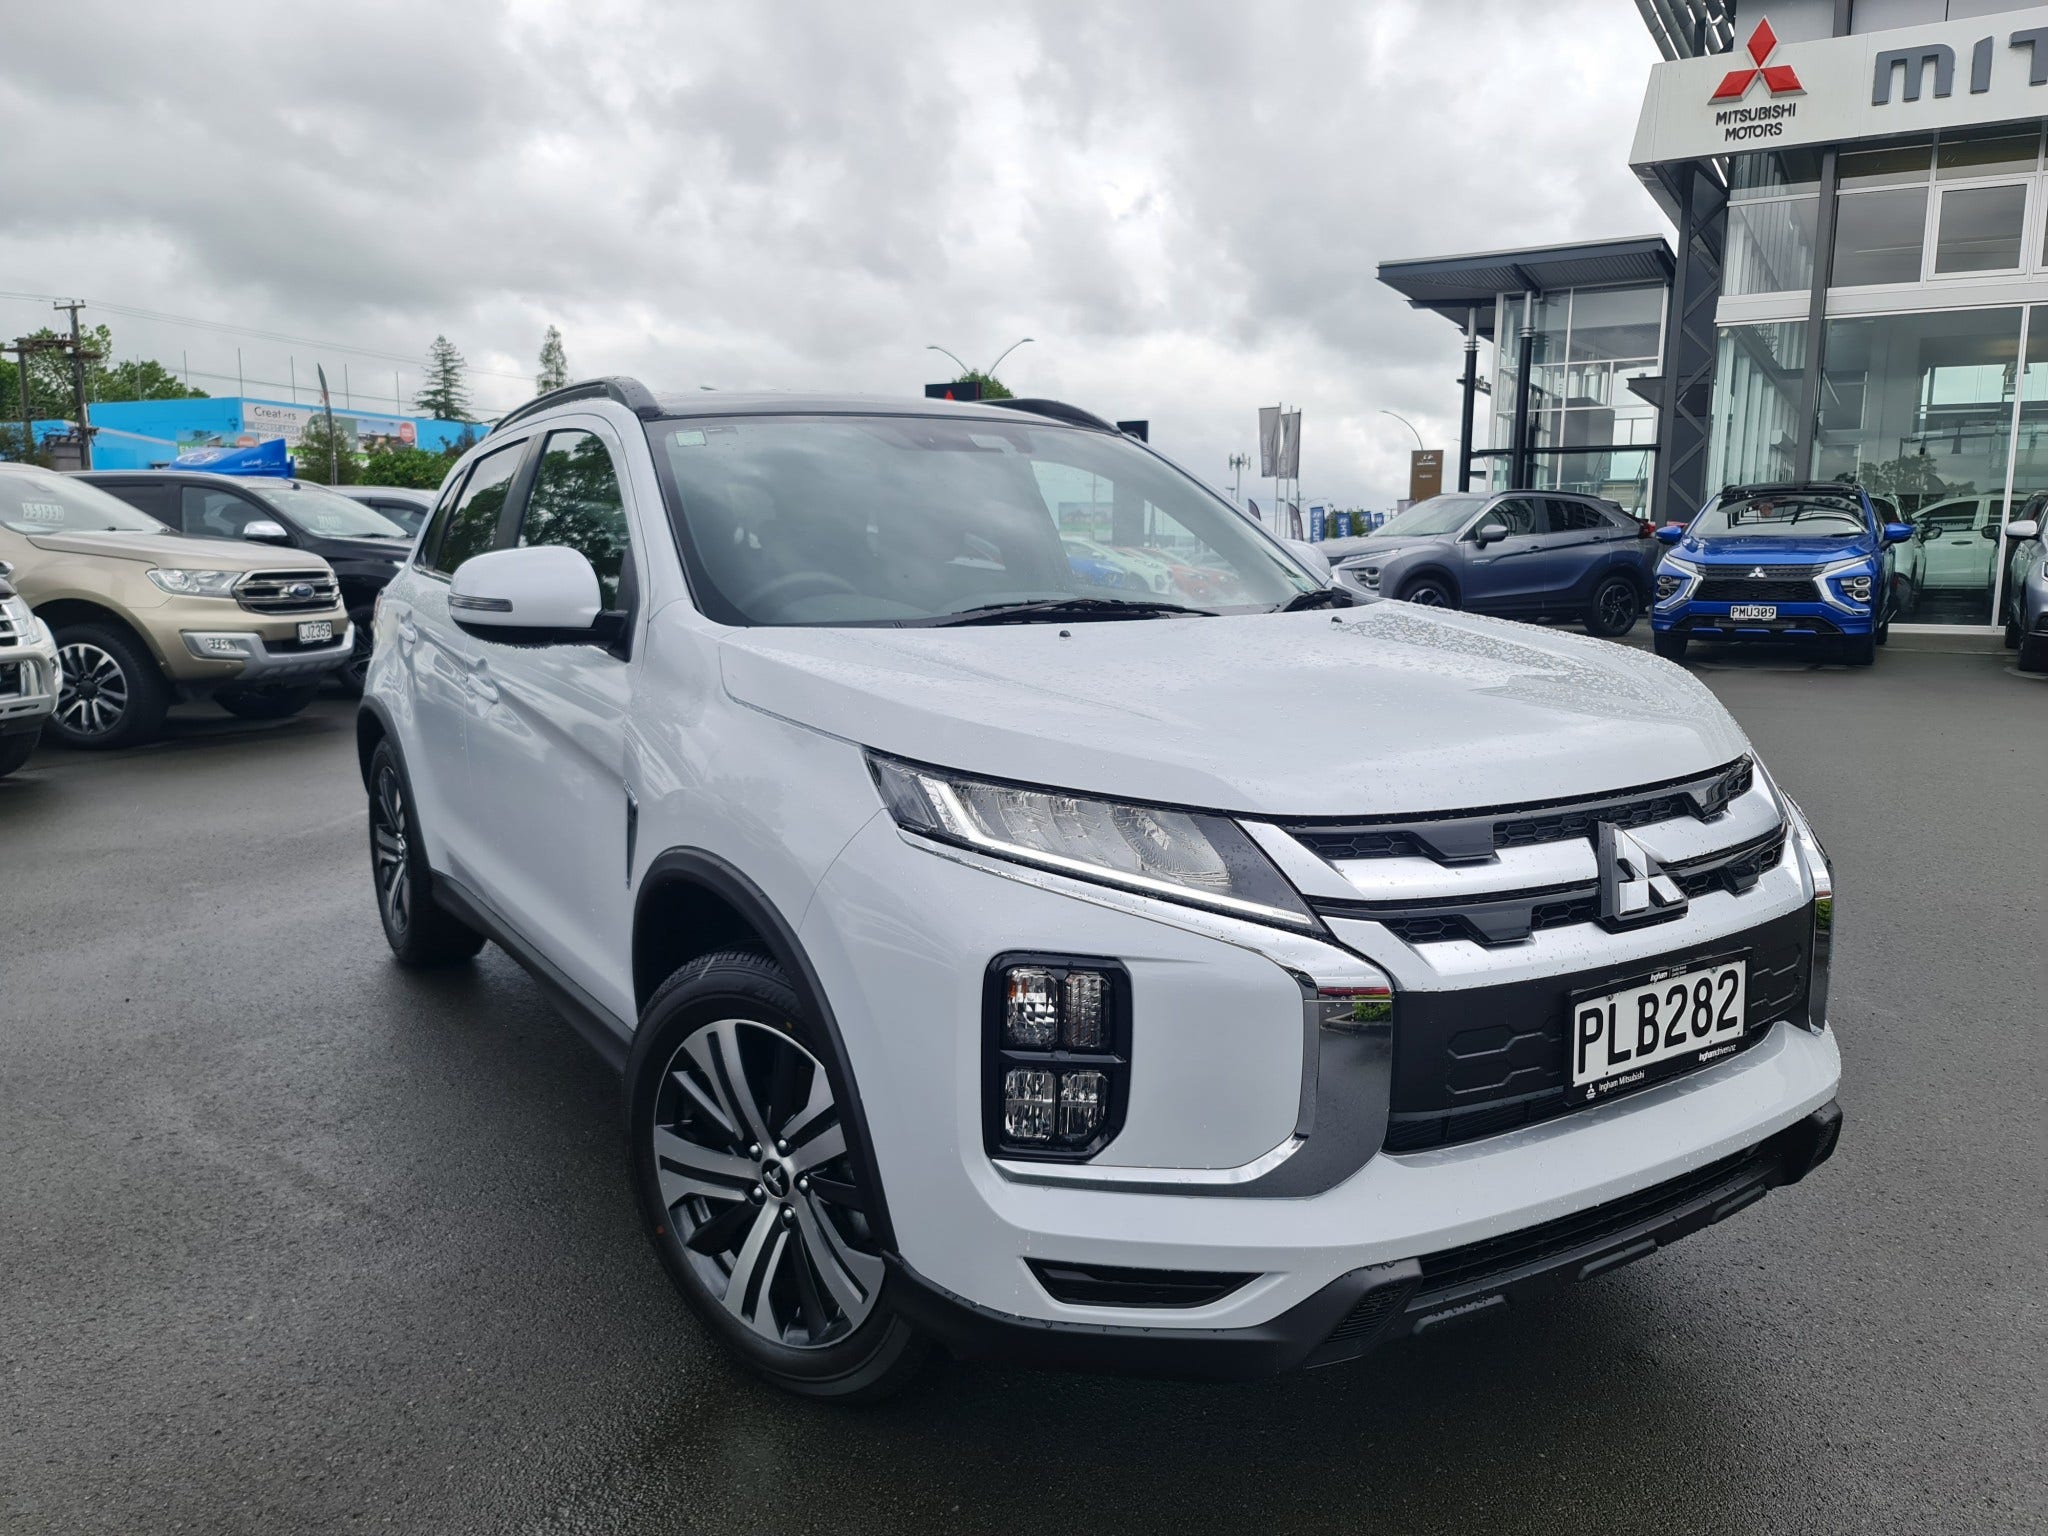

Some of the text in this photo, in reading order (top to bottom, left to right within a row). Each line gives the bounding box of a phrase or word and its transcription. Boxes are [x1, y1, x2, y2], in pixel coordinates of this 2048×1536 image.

[1715, 102, 1797, 126] MITSUBISHI
[1724, 121, 1783, 142] MOTORS
[1731, 606, 1775, 618] PMU309
[299, 623, 332, 640] LJZ359
[1577, 968, 1739, 1075] PLB282
[1598, 1069, 1645, 1093] Ingham Mitsubishi
